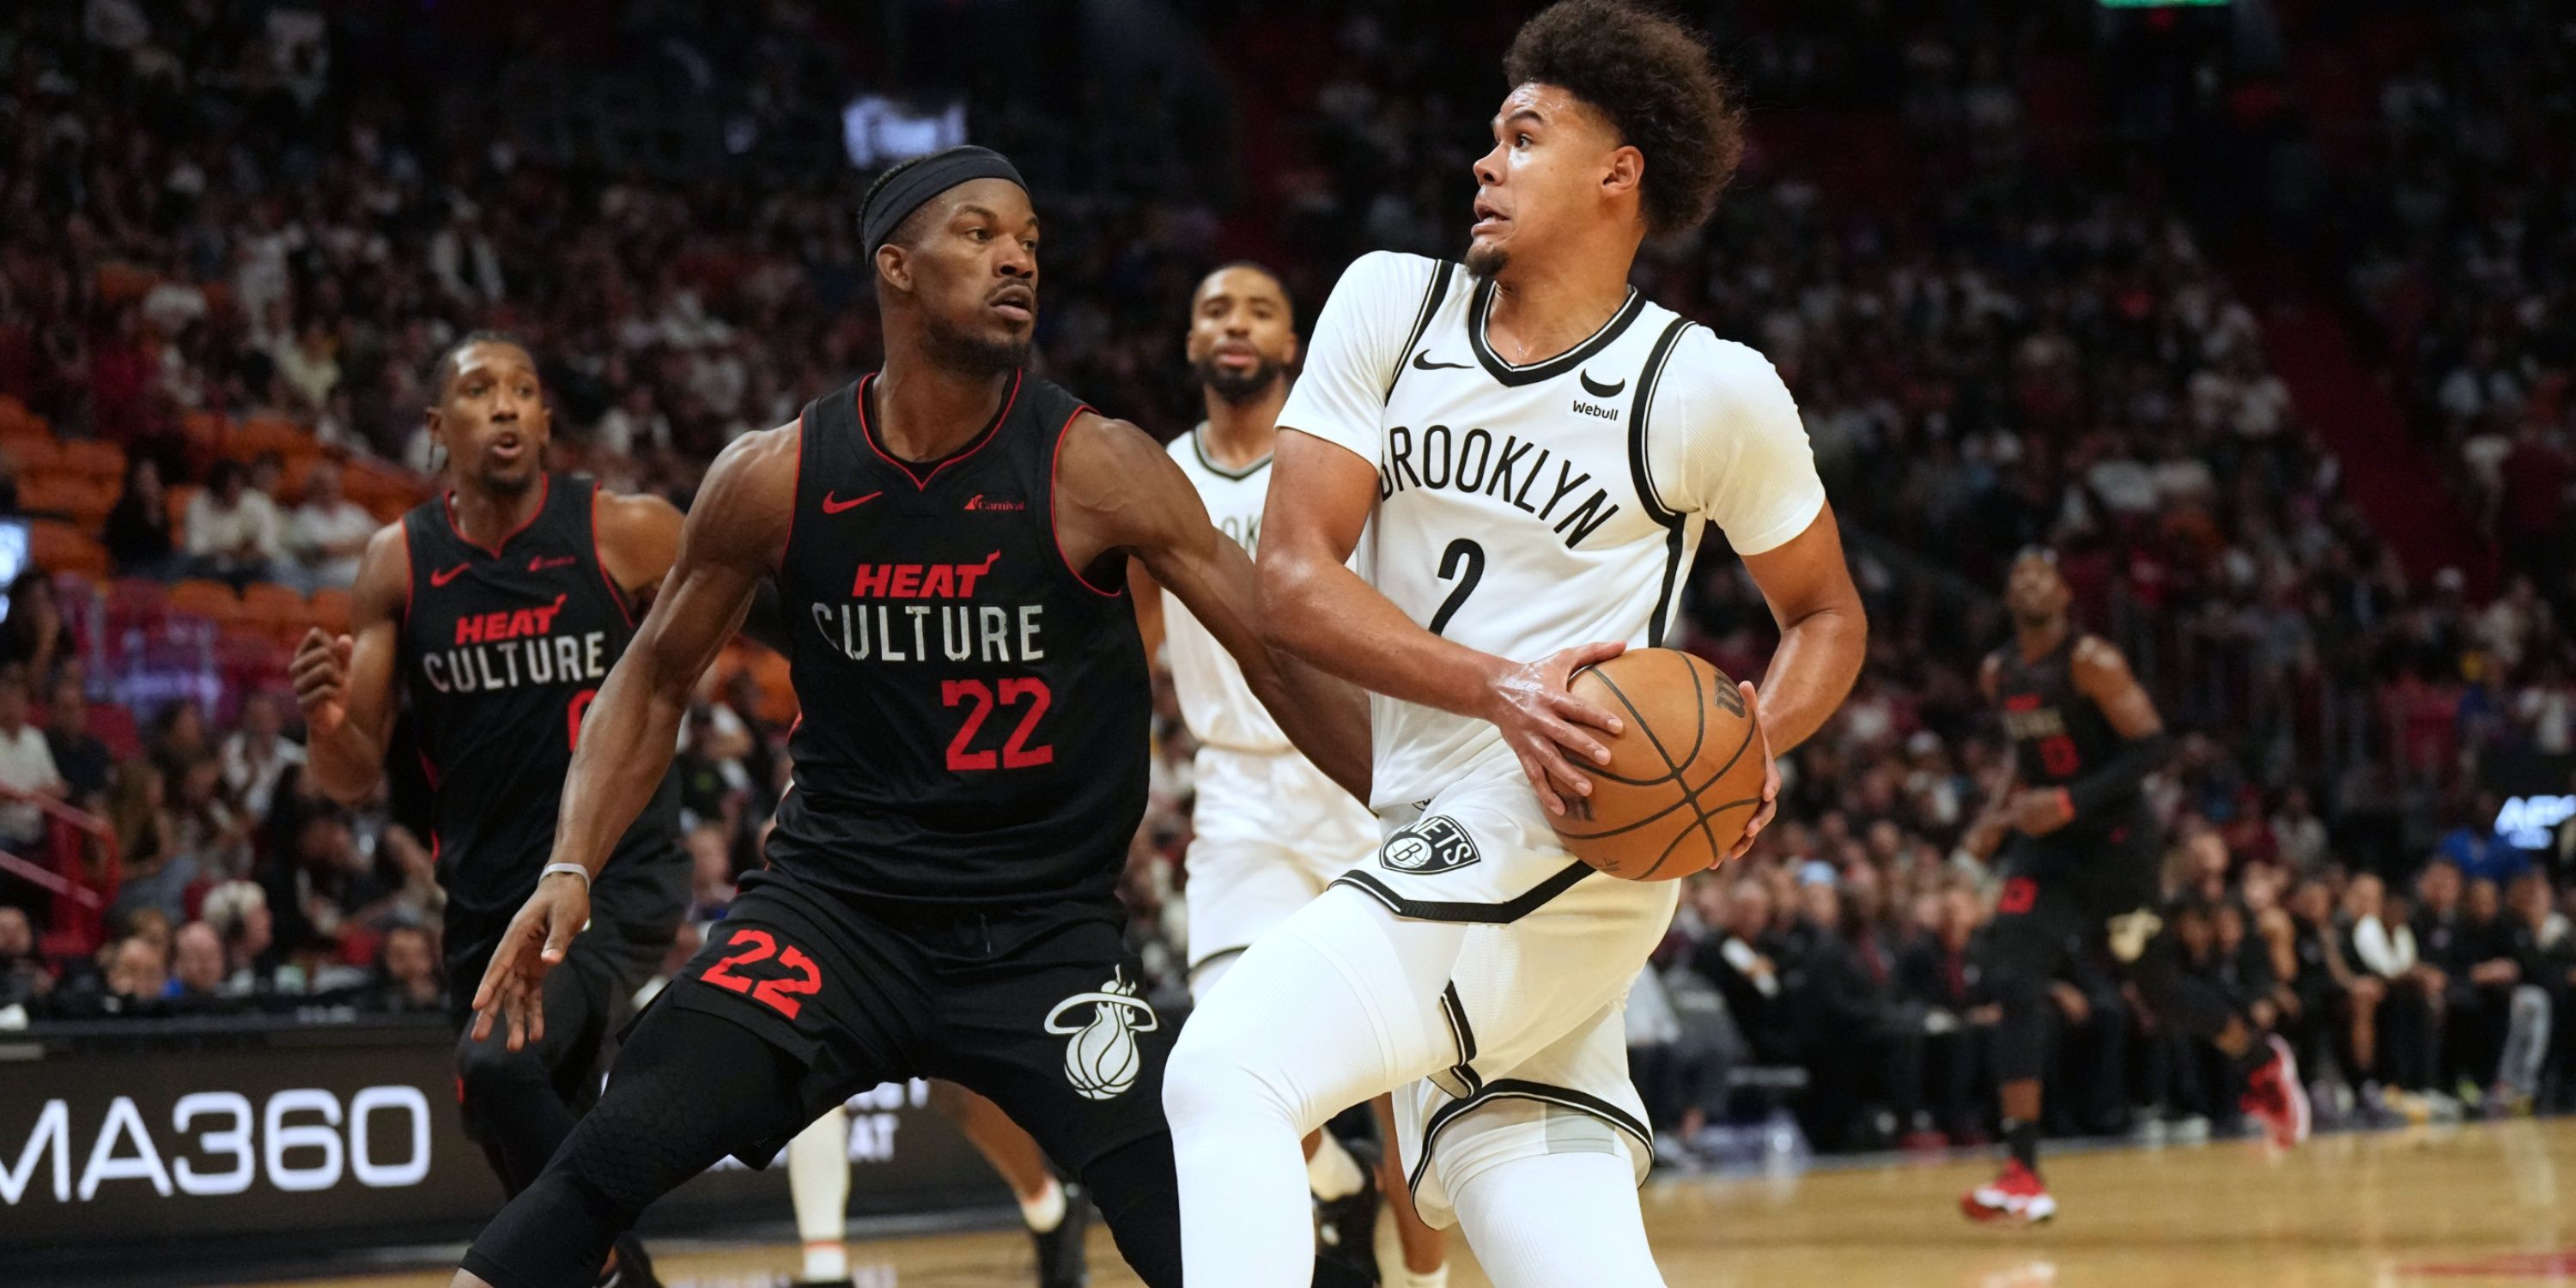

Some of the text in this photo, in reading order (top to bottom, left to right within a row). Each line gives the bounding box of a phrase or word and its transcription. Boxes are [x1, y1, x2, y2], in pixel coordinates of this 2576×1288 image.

[1573, 400, 1619, 421] Webull
[852, 550, 1000, 598] HEAT
[1430, 539, 1485, 636] 2
[455, 593, 567, 644] HEAT
[811, 602, 1043, 662] CULTURE
[424, 632, 605, 692] CULTURE
[941, 677, 1054, 770] 22
[701, 929, 822, 1019] 22
